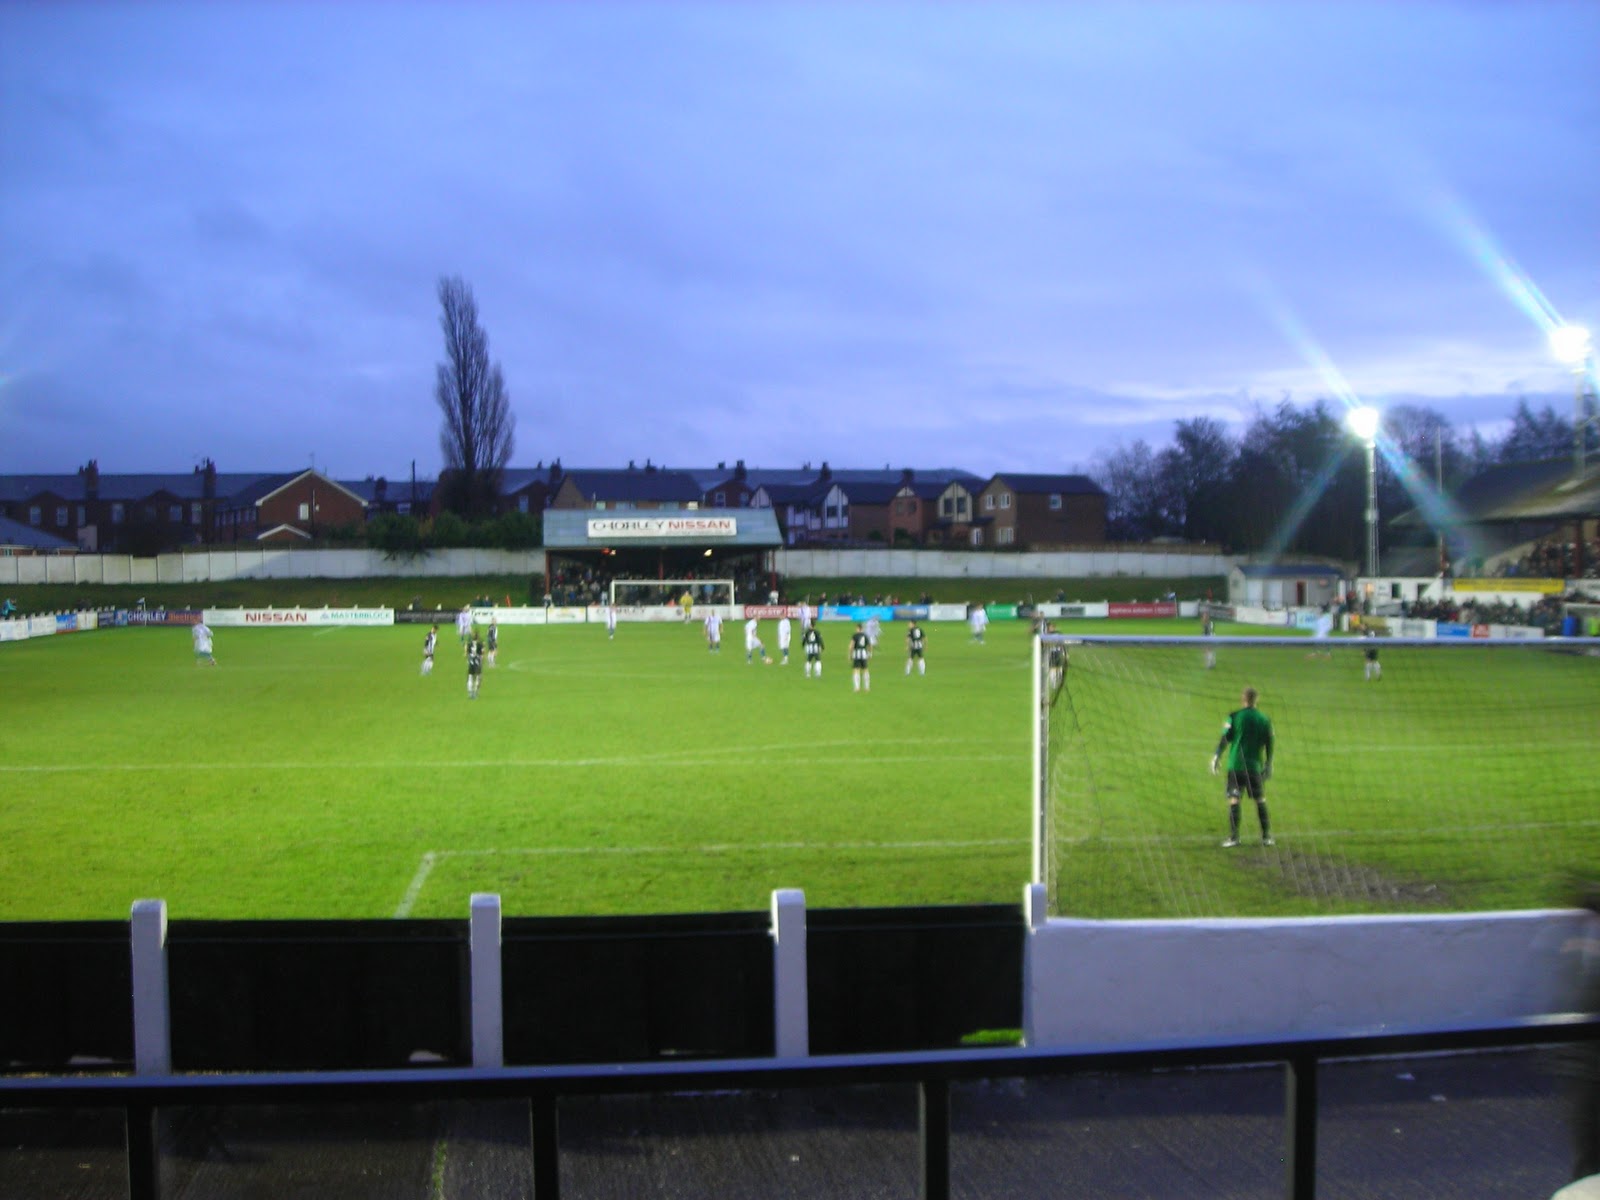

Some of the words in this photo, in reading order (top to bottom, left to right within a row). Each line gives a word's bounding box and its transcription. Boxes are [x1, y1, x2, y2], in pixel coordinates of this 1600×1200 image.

[593, 520, 664, 531] CHORLEY
[668, 519, 731, 530] NISSAN
[245, 612, 307, 622] NISSAN
